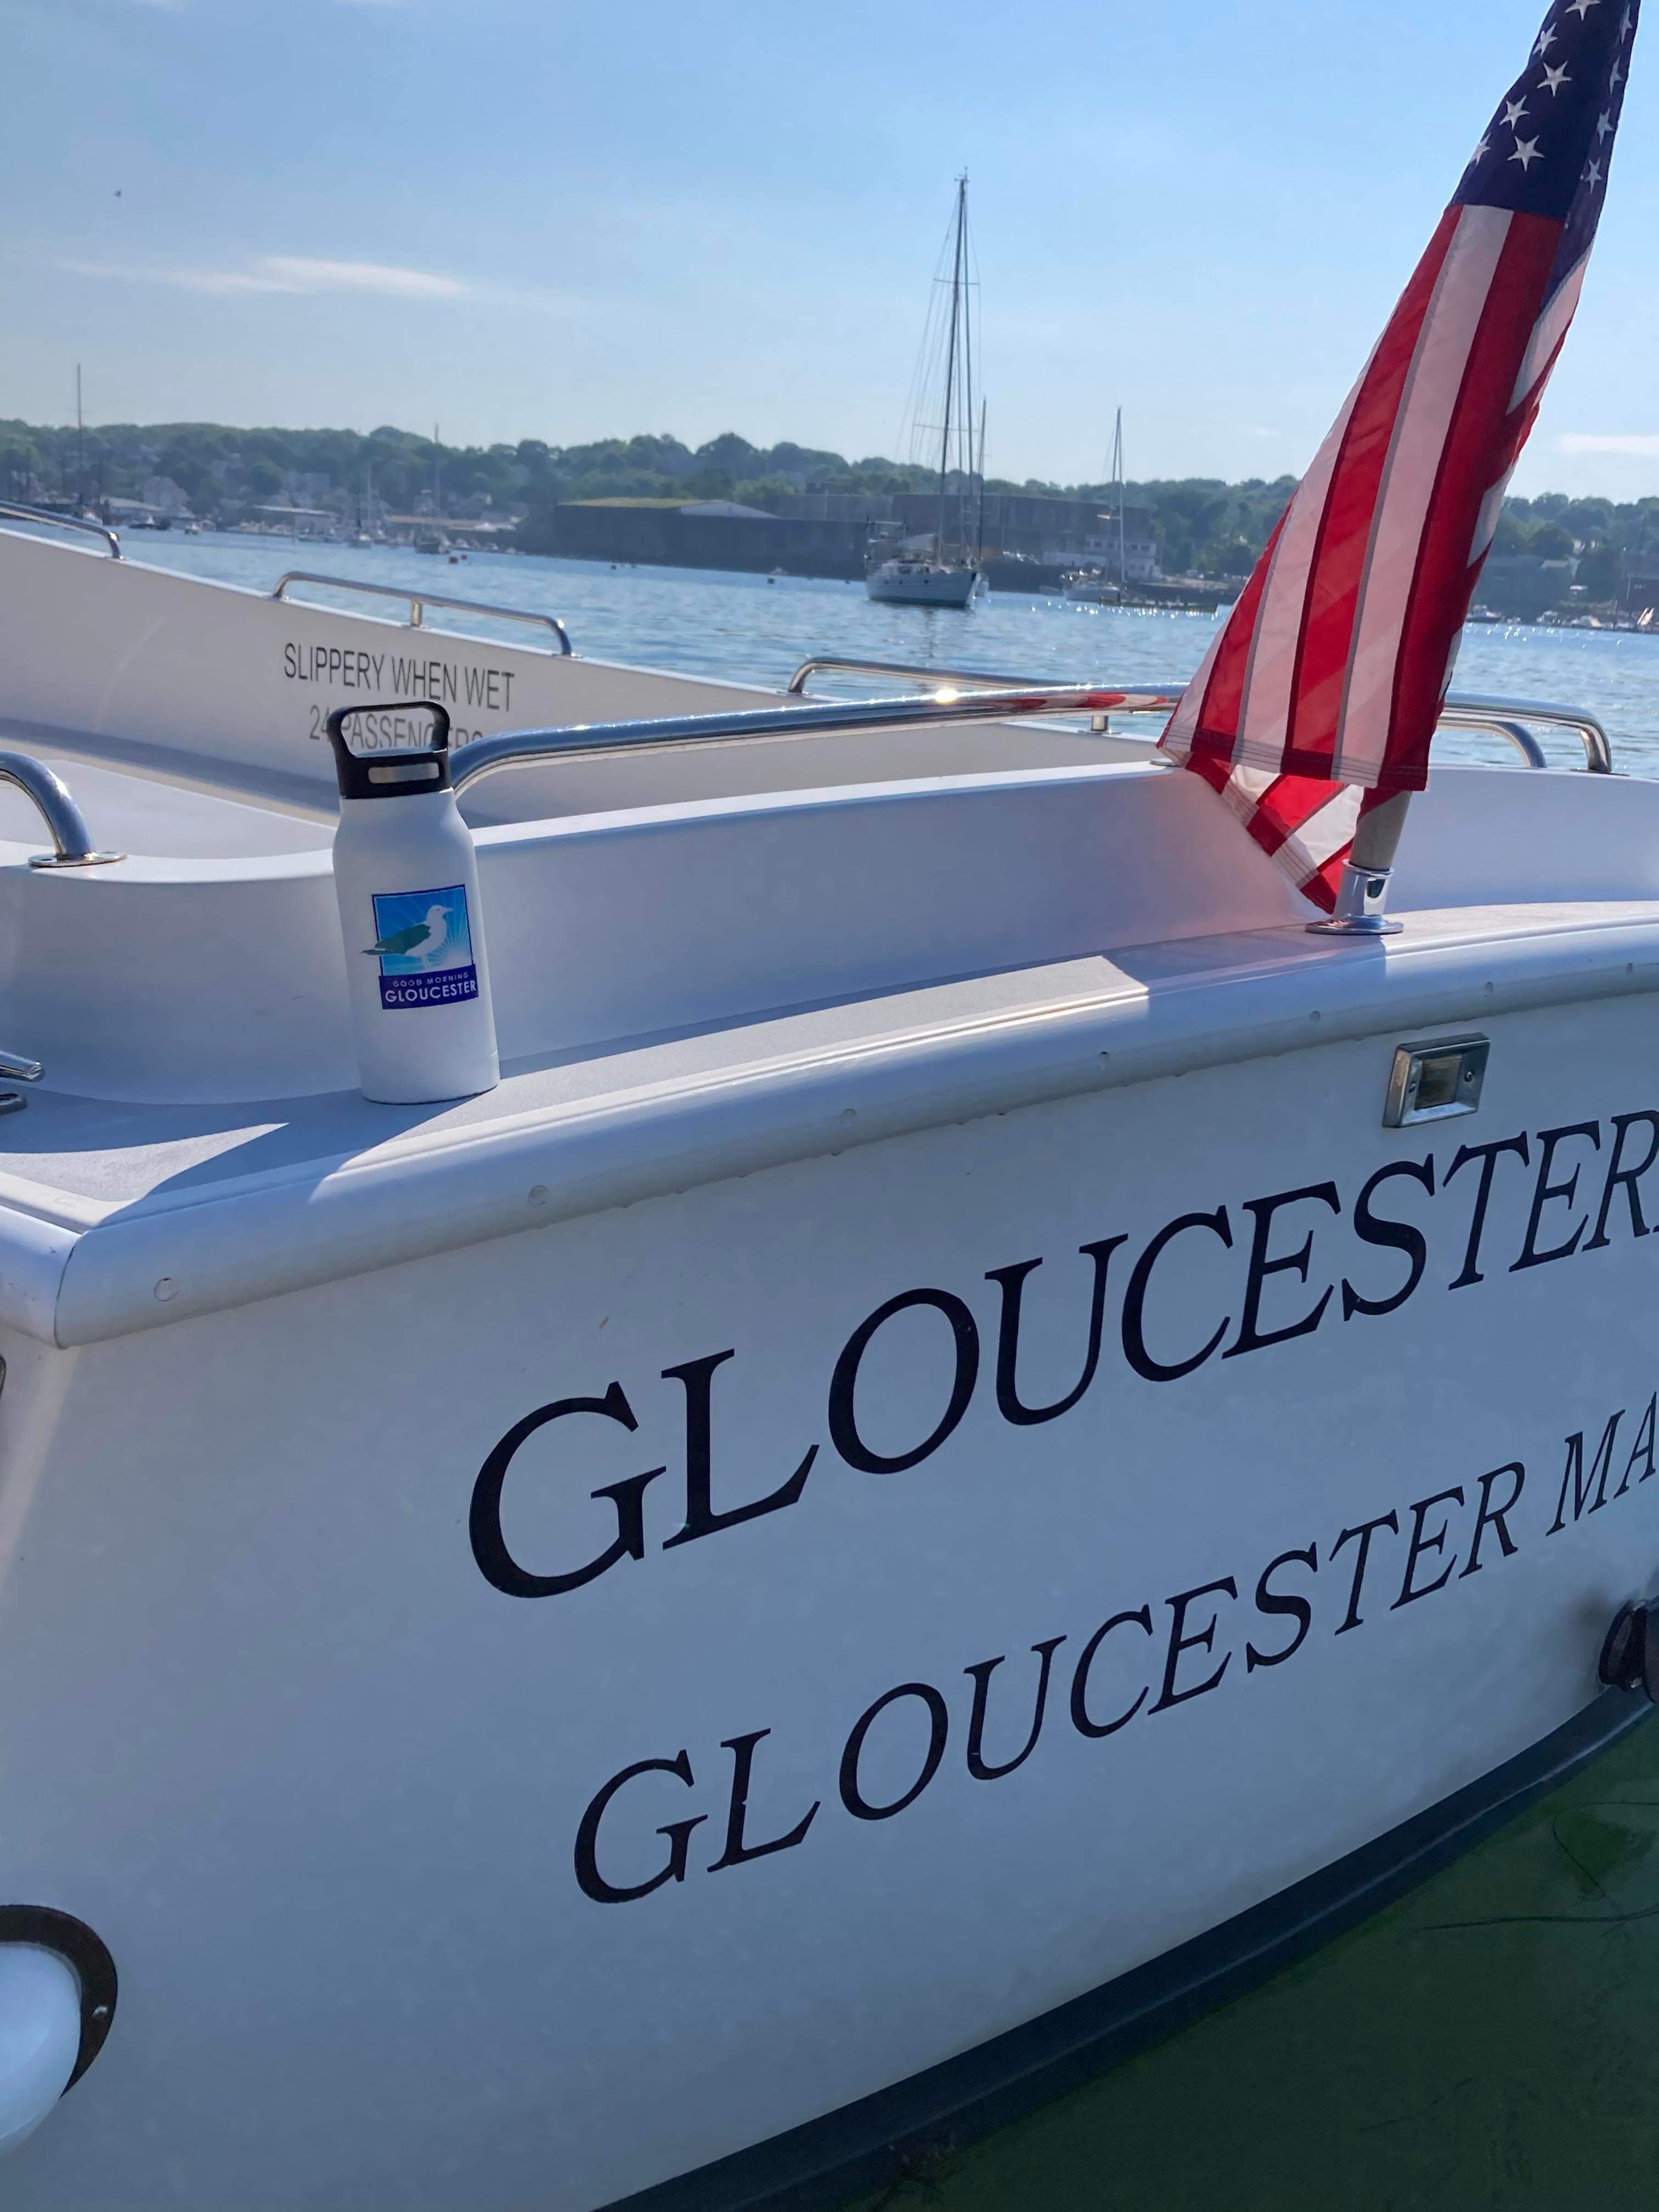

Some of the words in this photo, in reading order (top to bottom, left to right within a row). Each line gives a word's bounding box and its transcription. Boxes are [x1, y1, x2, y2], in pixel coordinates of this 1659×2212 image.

[284, 642, 385, 691] SLIPPERY
[392, 656, 458, 702] WHEN
[464, 667, 515, 712] WET
[385, 980, 476, 1003] GLOUCESTER
[393, 979, 422, 988] GOOD
[427, 972, 469, 985] MORNING
[469, 1110, 1659, 1598] GLOUCESTER
[574, 1462, 1525, 1903] GLOUCESTER
[1545, 1391, 1657, 1537] MA
